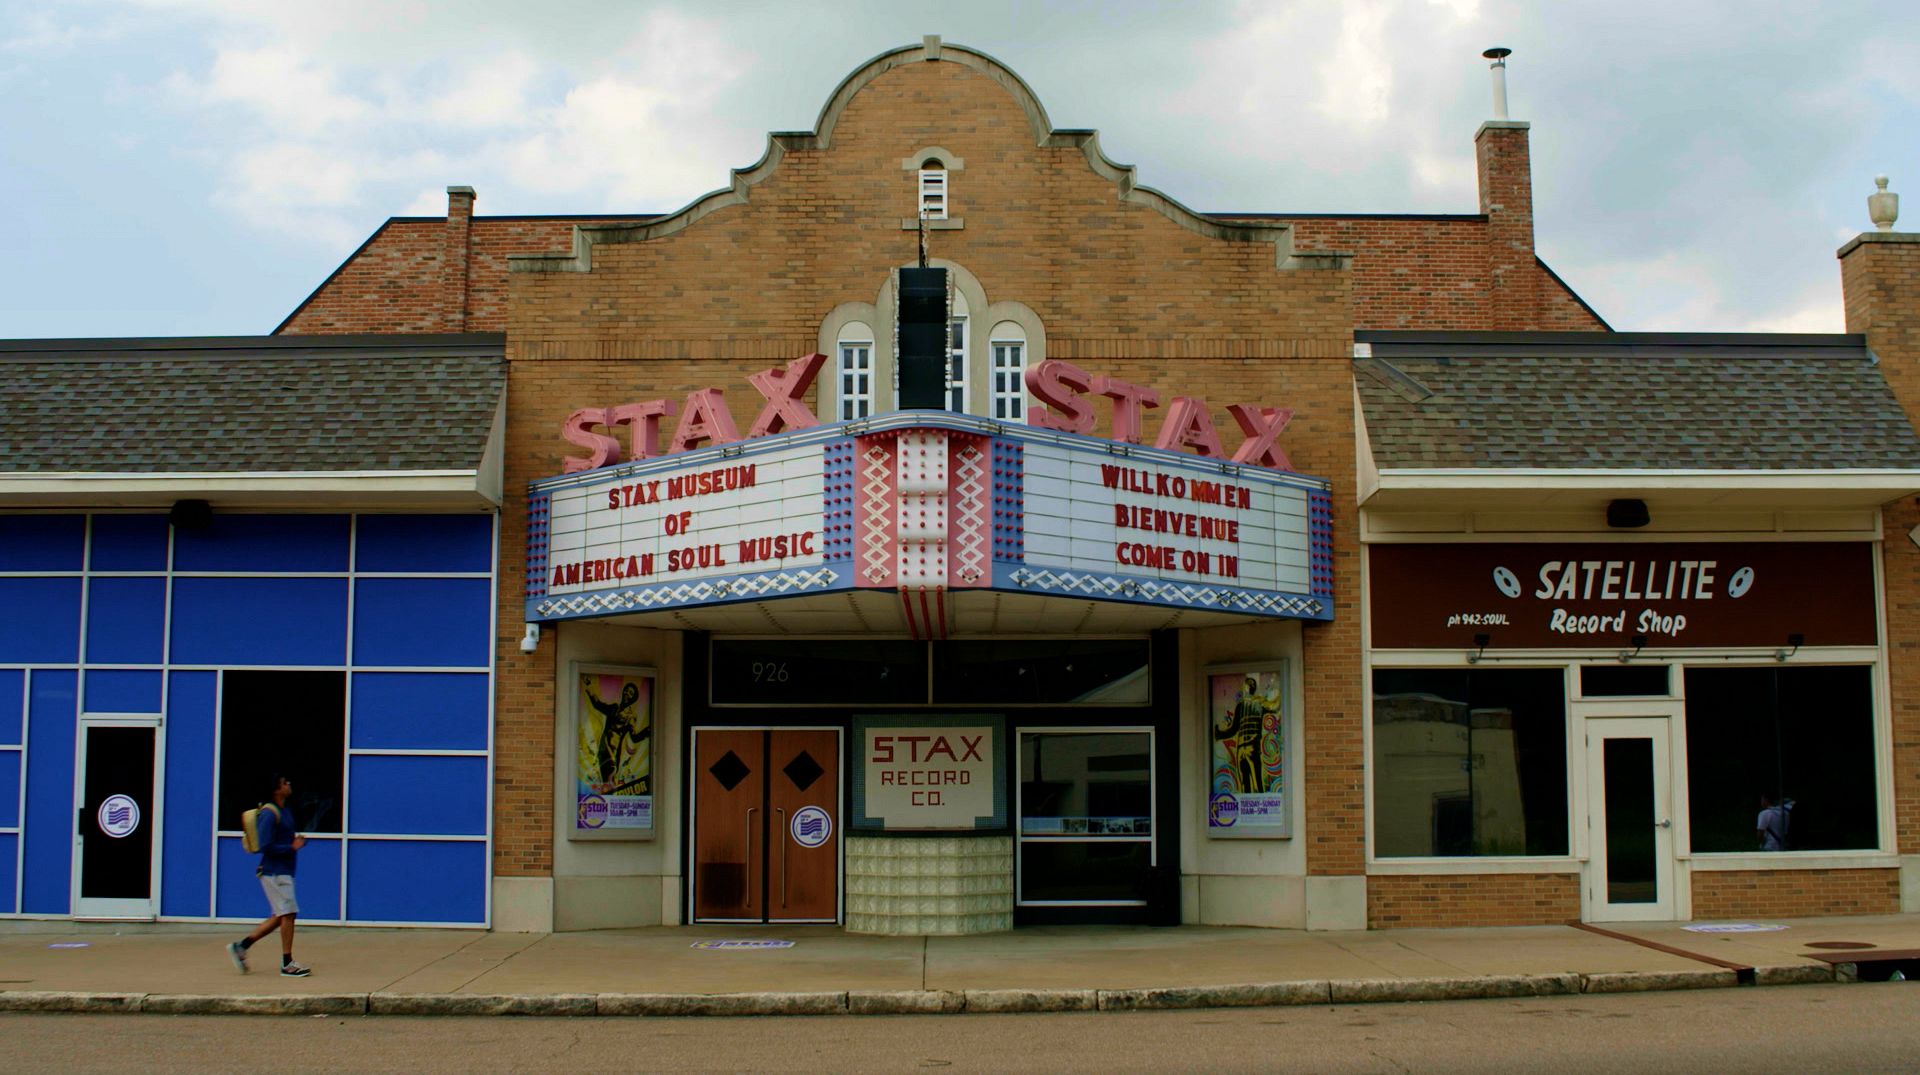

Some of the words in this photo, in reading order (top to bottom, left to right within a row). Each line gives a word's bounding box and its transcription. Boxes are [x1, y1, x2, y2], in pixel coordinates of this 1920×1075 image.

[560, 352, 829, 474] STAX
[1024, 359, 1296, 474] STAX
[608, 479, 660, 511] STAX
[667, 463, 756, 501] MUSEUM
[1101, 463, 1251, 511] WILLKOMMEN
[664, 511, 692, 537] OF
[1115, 503, 1240, 543] BIENVENUE
[553, 552, 654, 587] AMERICAN
[668, 543, 726, 573] SOUL
[739, 531, 814, 564] MUSIC
[1117, 541, 1177, 571] COME
[1182, 549, 1211, 575] ON
[1218, 553, 1239, 578] IN
[1535, 560, 1718, 600] SATELLITE
[1550, 608, 1626, 634] Record
[1637, 608, 1687, 637] Shop
[751, 662, 789, 683] 926
[872, 735, 984, 763] STAX
[881, 770, 971, 786] RECORD
[911, 791, 945, 806] CO.
